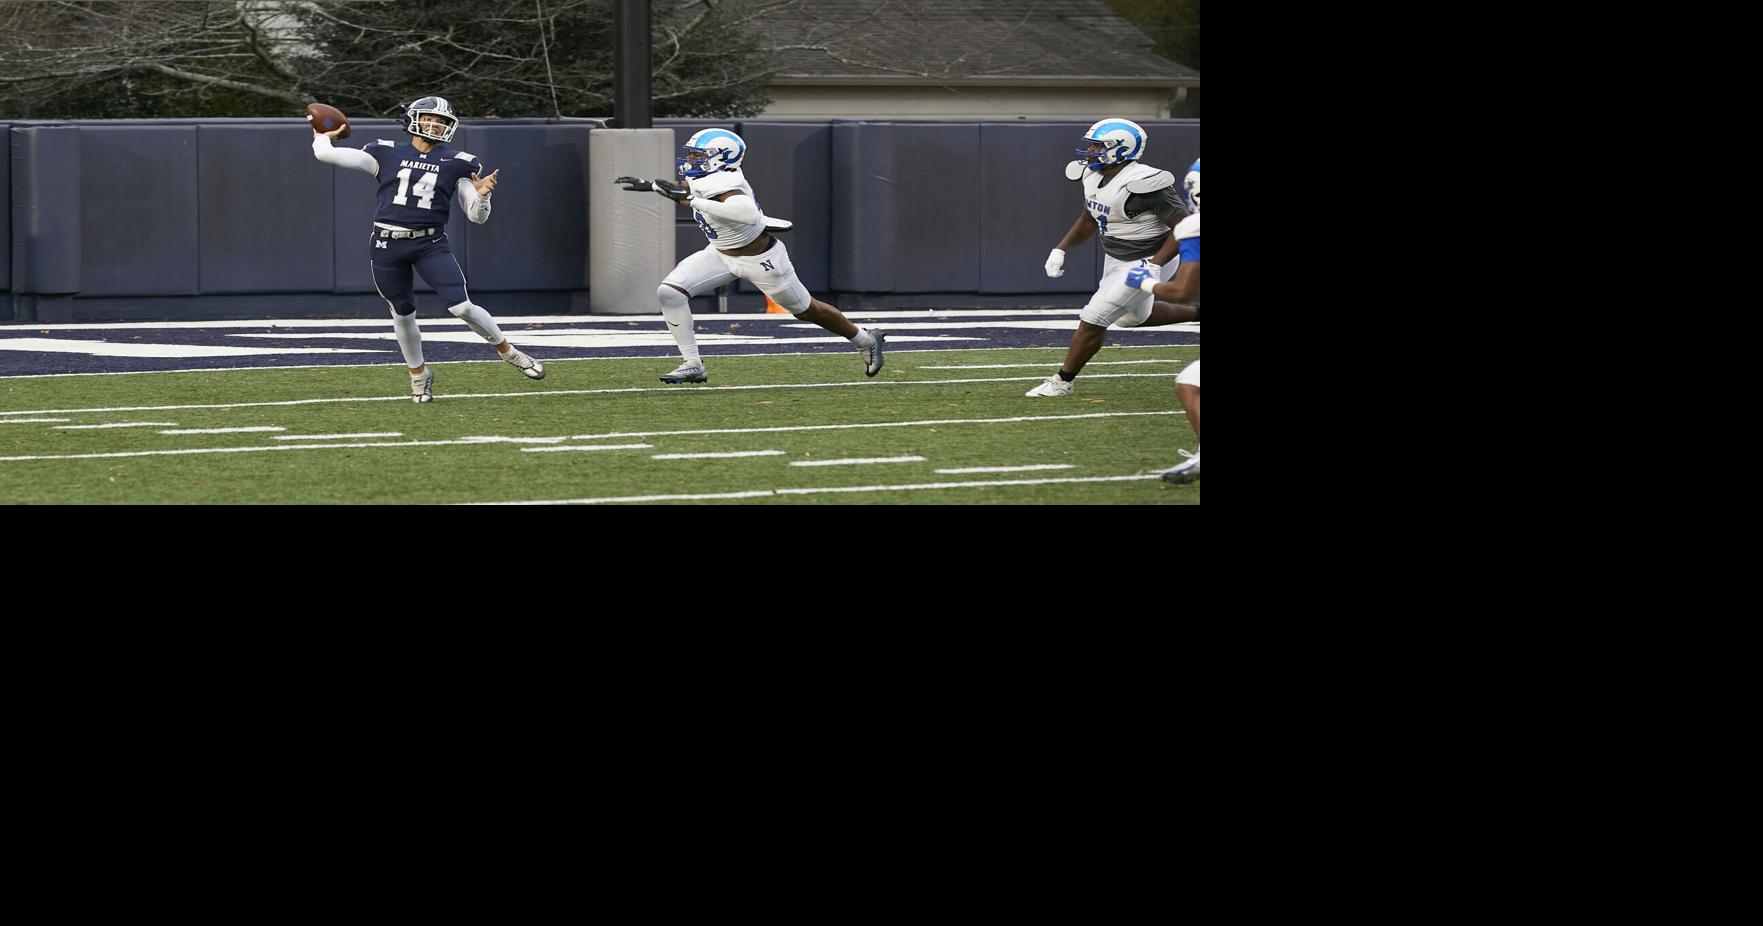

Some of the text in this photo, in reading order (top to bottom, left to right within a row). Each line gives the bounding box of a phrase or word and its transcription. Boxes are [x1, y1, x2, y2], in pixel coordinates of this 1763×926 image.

[399, 159, 440, 172] MARIETTA
[392, 168, 438, 209] 14
[375, 240, 388, 249] M
[760, 259, 775, 271] N
